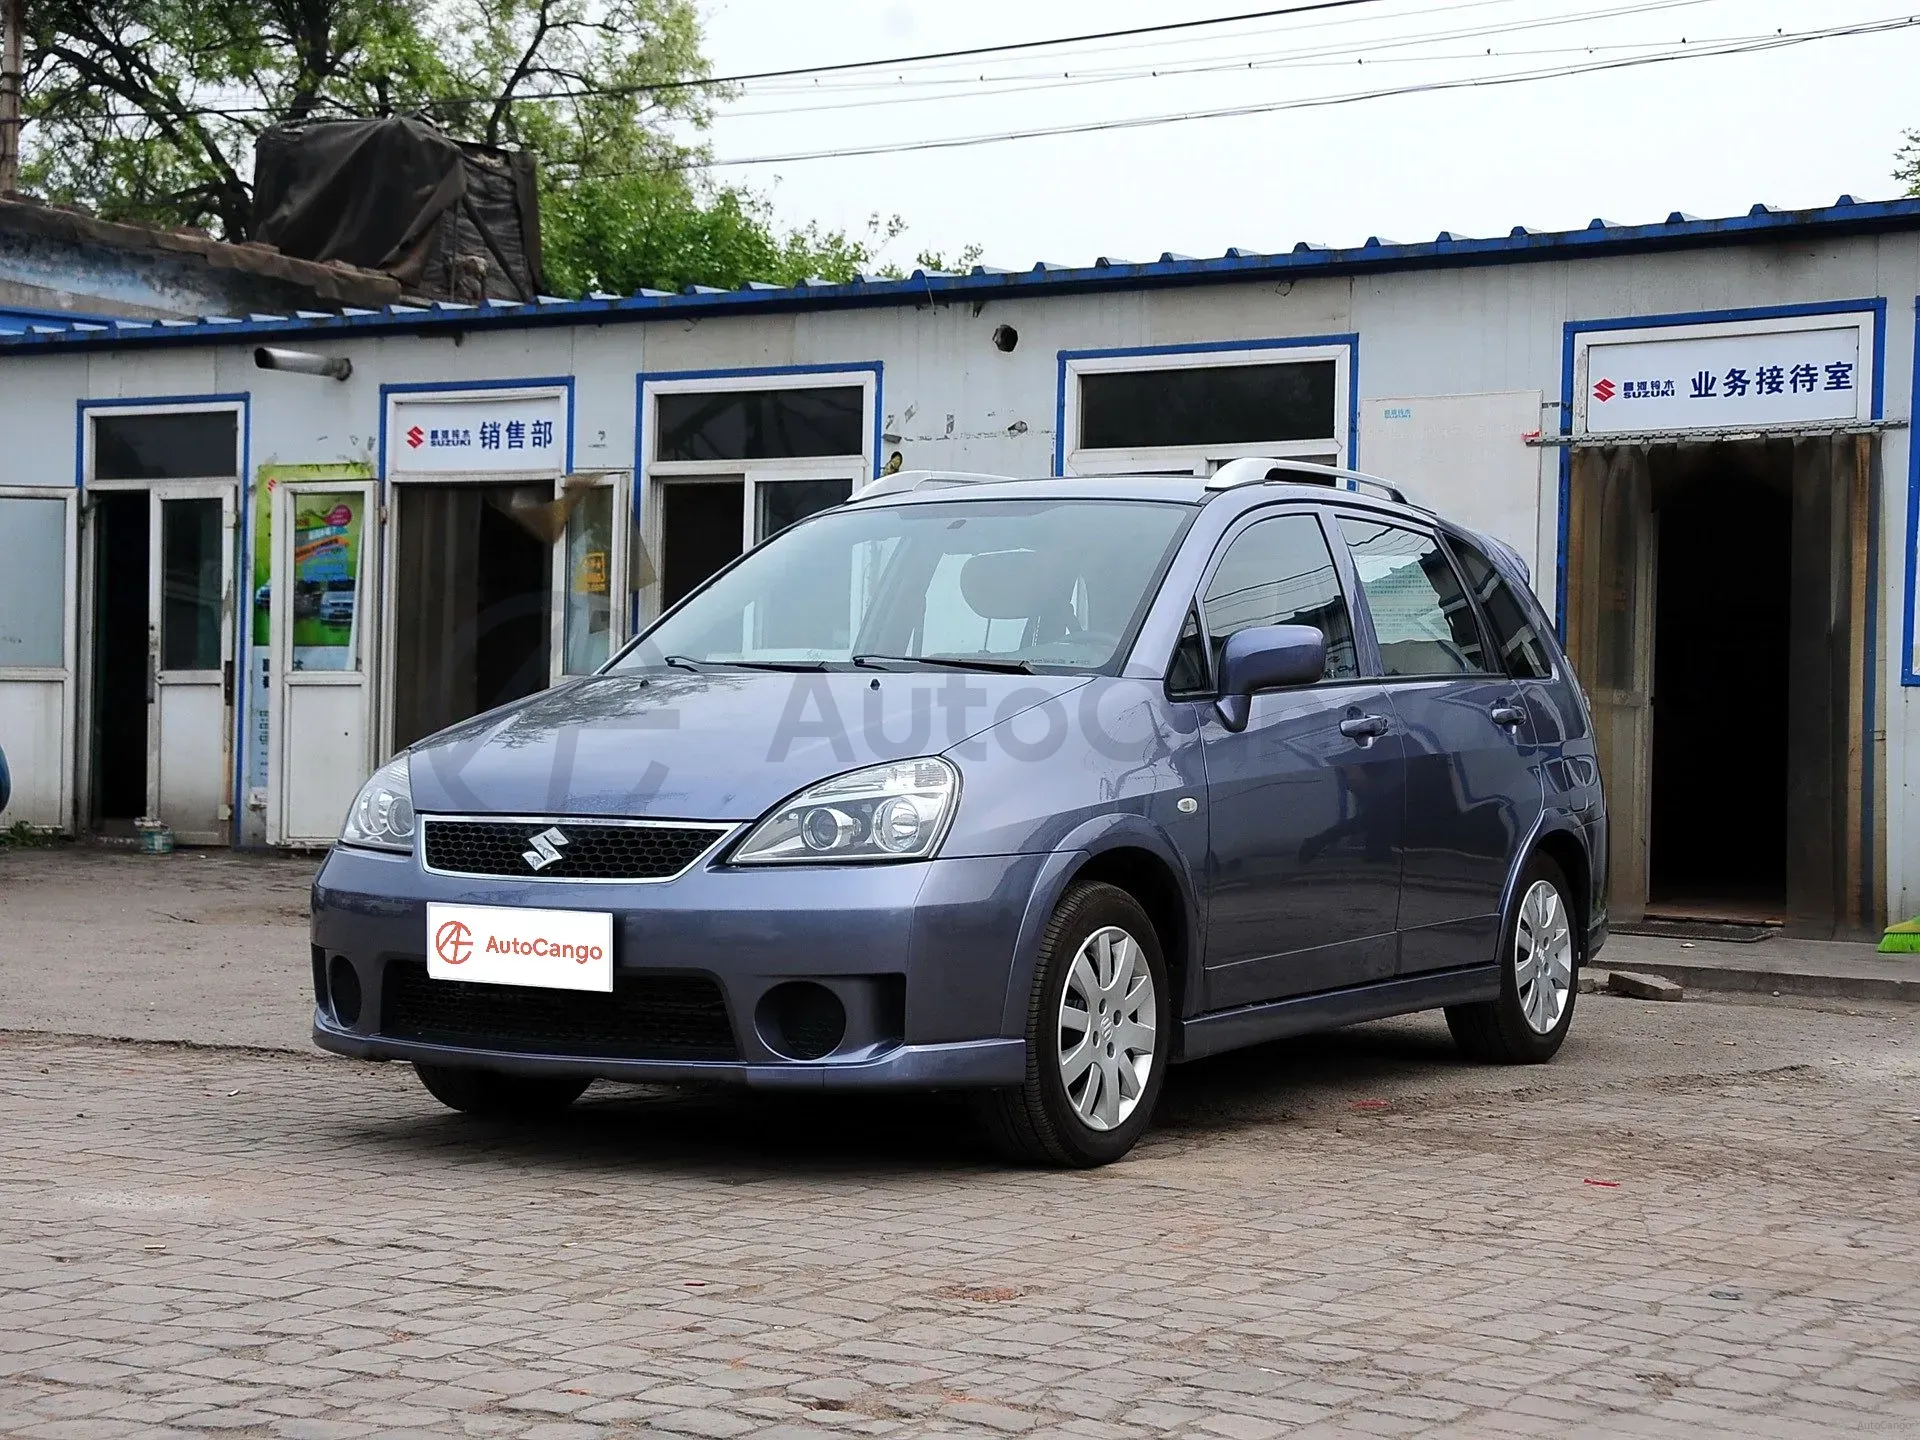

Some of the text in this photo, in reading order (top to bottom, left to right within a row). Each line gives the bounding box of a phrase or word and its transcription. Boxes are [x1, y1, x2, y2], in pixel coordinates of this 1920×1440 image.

[1690, 361, 1853, 398] 业务接待室
[1623, 389, 1675, 399] SUZUKI
[430, 438, 472, 447] SUZUKI
[479, 420, 553, 450] 销售部
